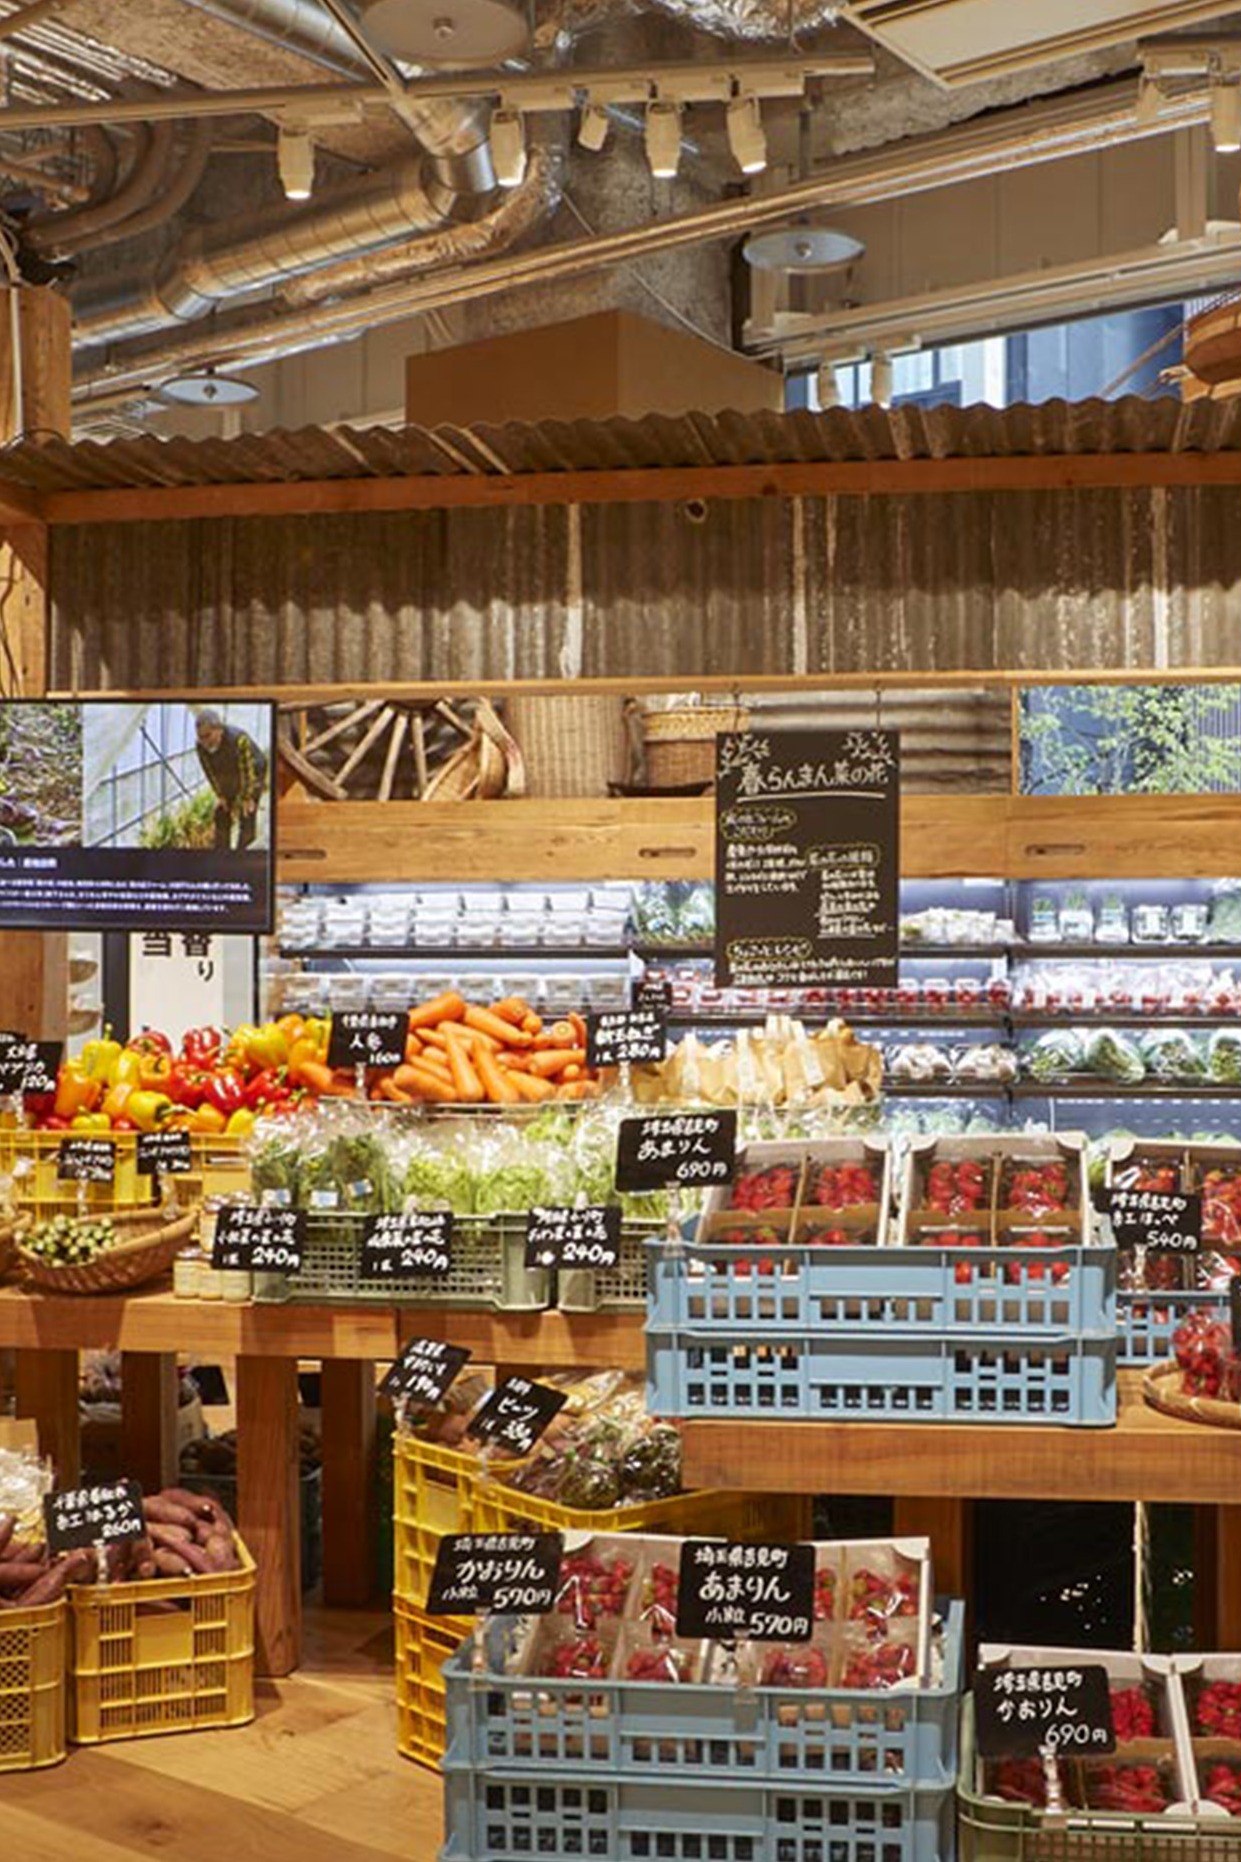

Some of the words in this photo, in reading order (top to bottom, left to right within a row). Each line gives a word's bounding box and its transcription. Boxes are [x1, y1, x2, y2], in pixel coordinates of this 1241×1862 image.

[637, 1136, 713, 1160] あまりん
[675, 1160, 729, 1180] 690円
[1146, 1230, 1198, 1250] 540円
[250, 1245, 300, 1268] 240円
[400, 1248, 449, 1271] 240円
[561, 1241, 616, 1265] 240円
[694, 1545, 789, 1570] 埼玉県吉見町
[456, 1558, 546, 1585] かおりん
[699, 1570, 792, 1603] あまりん
[704, 1604, 746, 1624] 小粒
[996, 1696, 1078, 1723] かおりん
[1044, 1723, 1108, 1746] 690円
